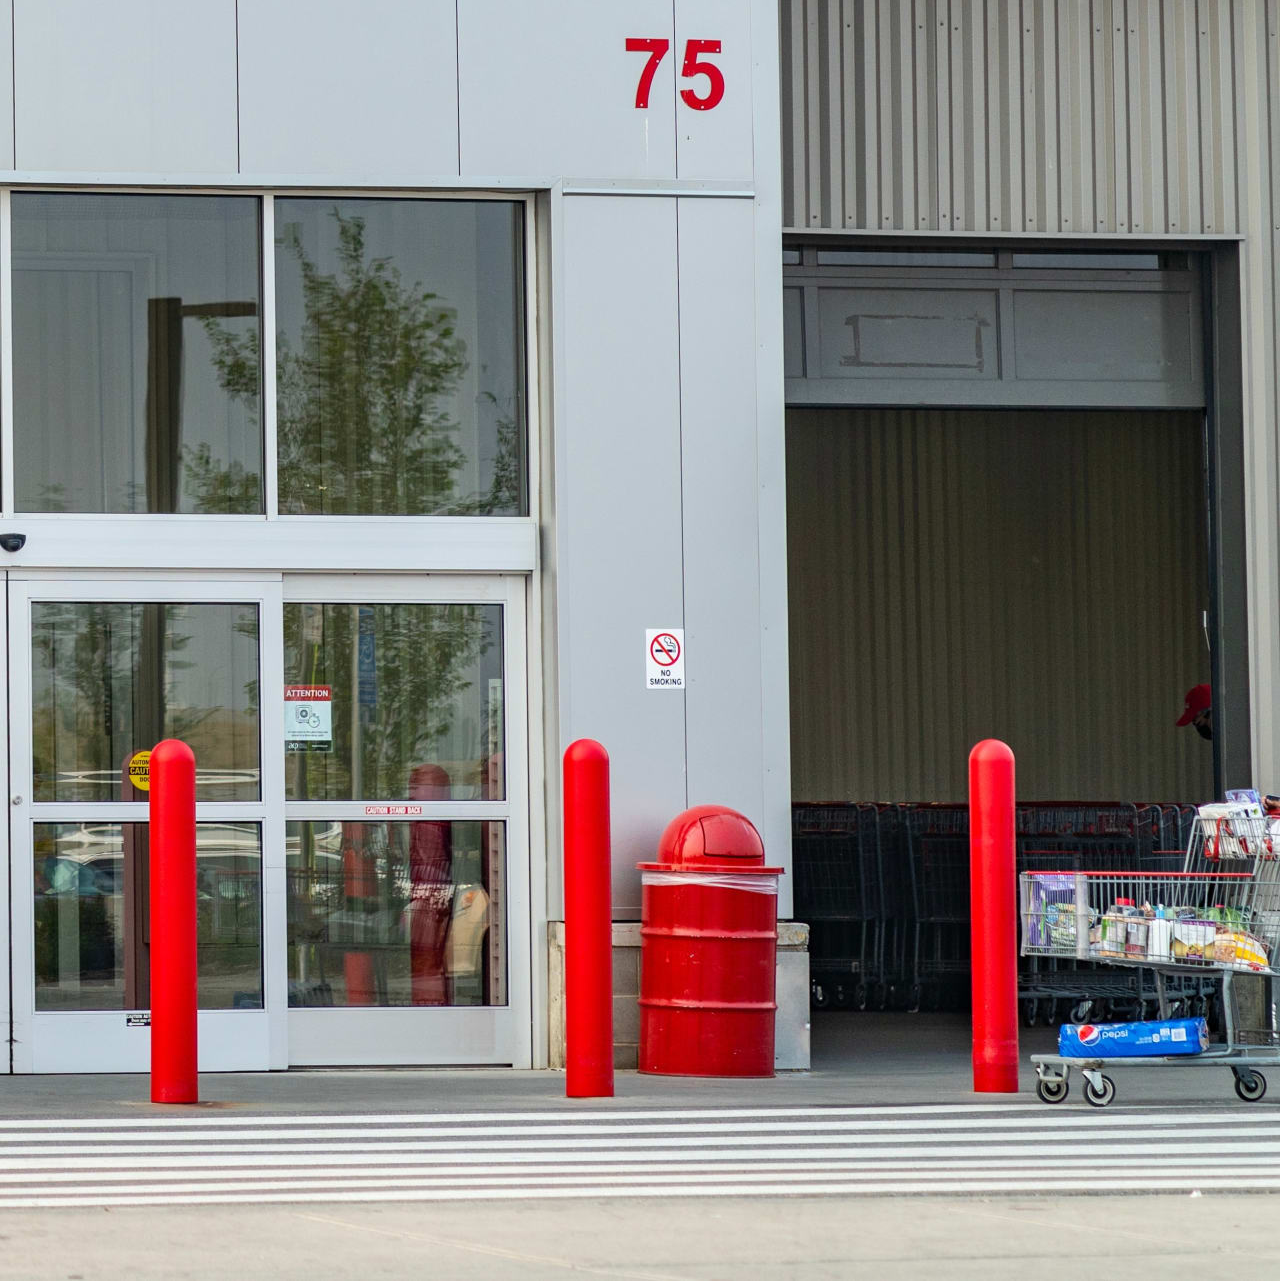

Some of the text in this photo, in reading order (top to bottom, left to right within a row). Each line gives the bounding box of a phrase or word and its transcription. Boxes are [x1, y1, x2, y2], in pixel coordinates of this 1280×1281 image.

[626, 38, 724, 110] 75
[286, 689, 328, 697] ATTENTION
[366, 806, 421, 814] CAUTION STAND BACK
[1101, 1030, 1128, 1039] pepsi
